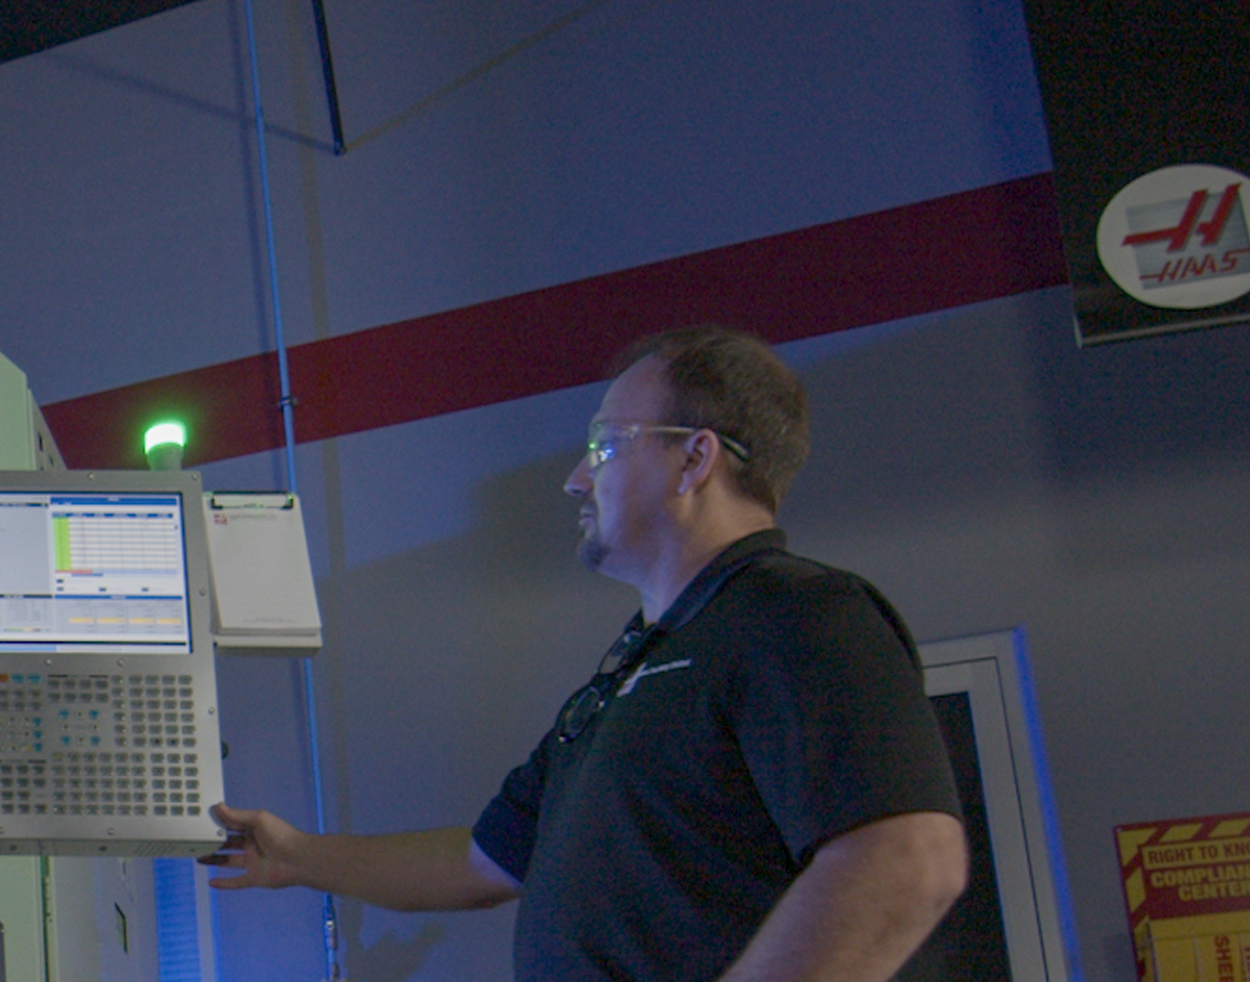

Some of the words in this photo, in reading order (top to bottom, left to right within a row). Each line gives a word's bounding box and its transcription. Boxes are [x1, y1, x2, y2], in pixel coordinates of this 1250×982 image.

[1139, 247, 1250, 283] HAAS
[1147, 847, 1194, 865] RIGHT
[1198, 845, 1218, 859] TO
